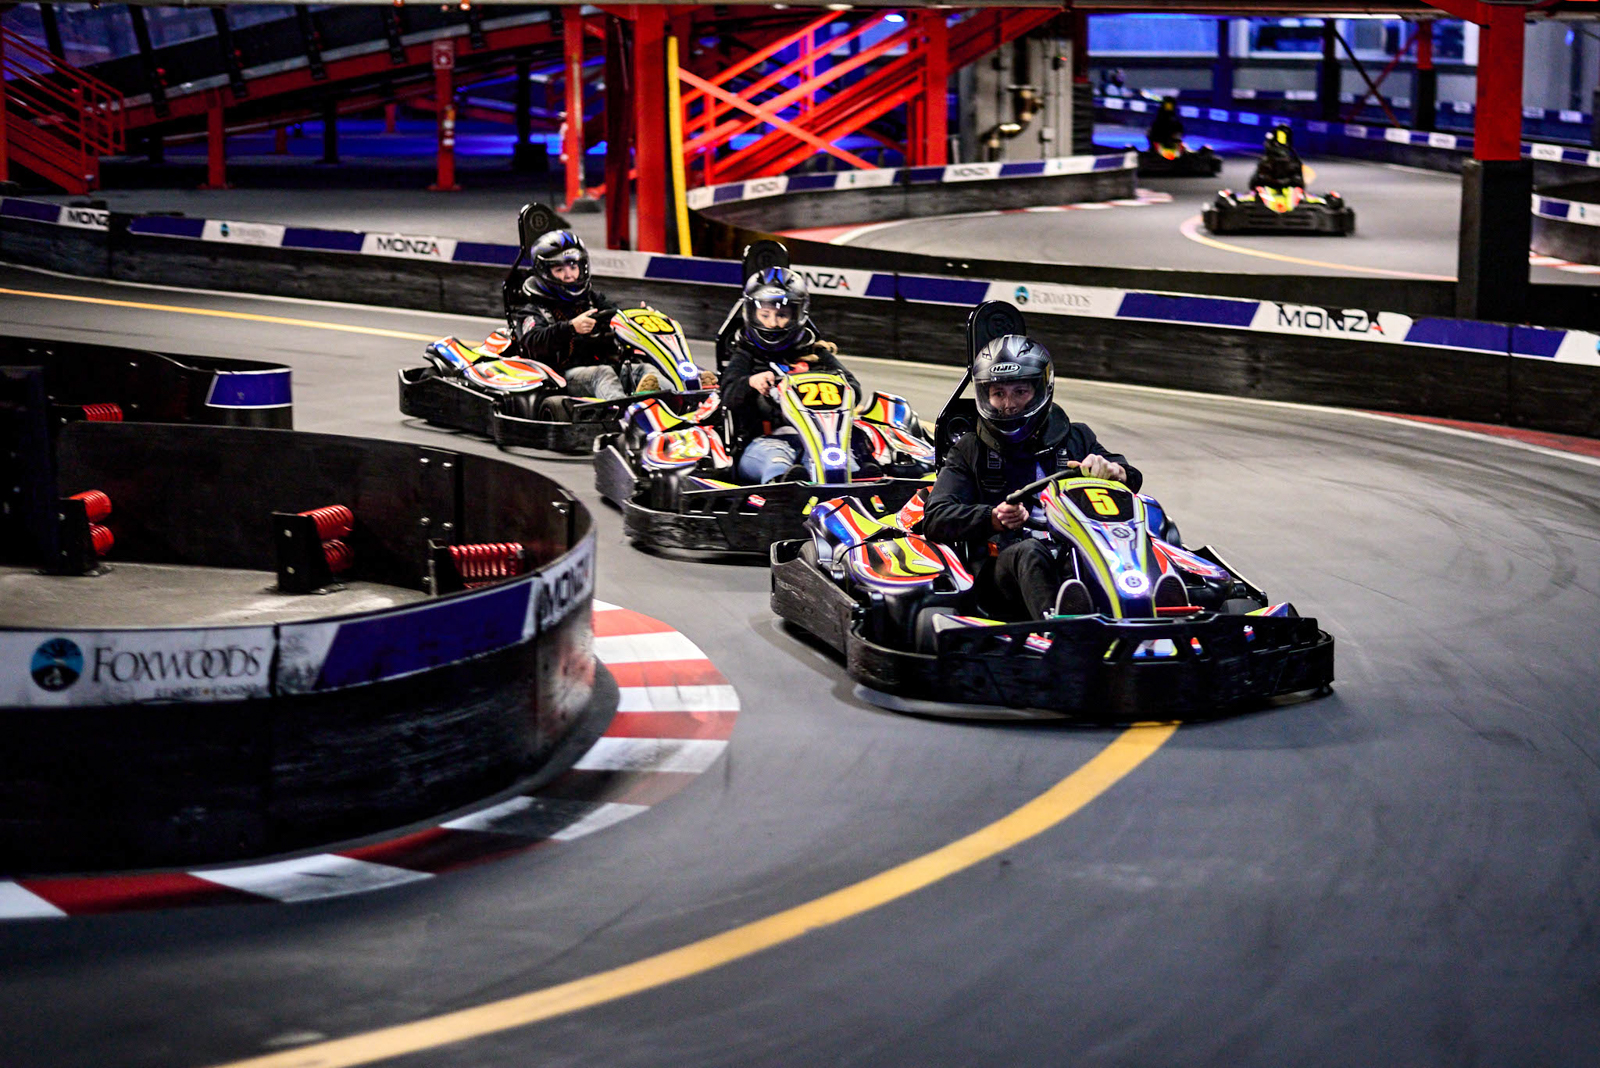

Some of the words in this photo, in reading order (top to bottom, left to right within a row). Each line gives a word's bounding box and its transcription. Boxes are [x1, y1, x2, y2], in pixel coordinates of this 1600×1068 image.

[68, 210, 110, 226] MONZ
[377, 237, 440, 256] MONZA
[794, 271, 850, 290] NZA
[1278, 305, 1385, 335] MONZA
[798, 382, 842, 406] 28
[1083, 488, 1120, 516] 5
[92, 646, 262, 683] FOXWOODS
